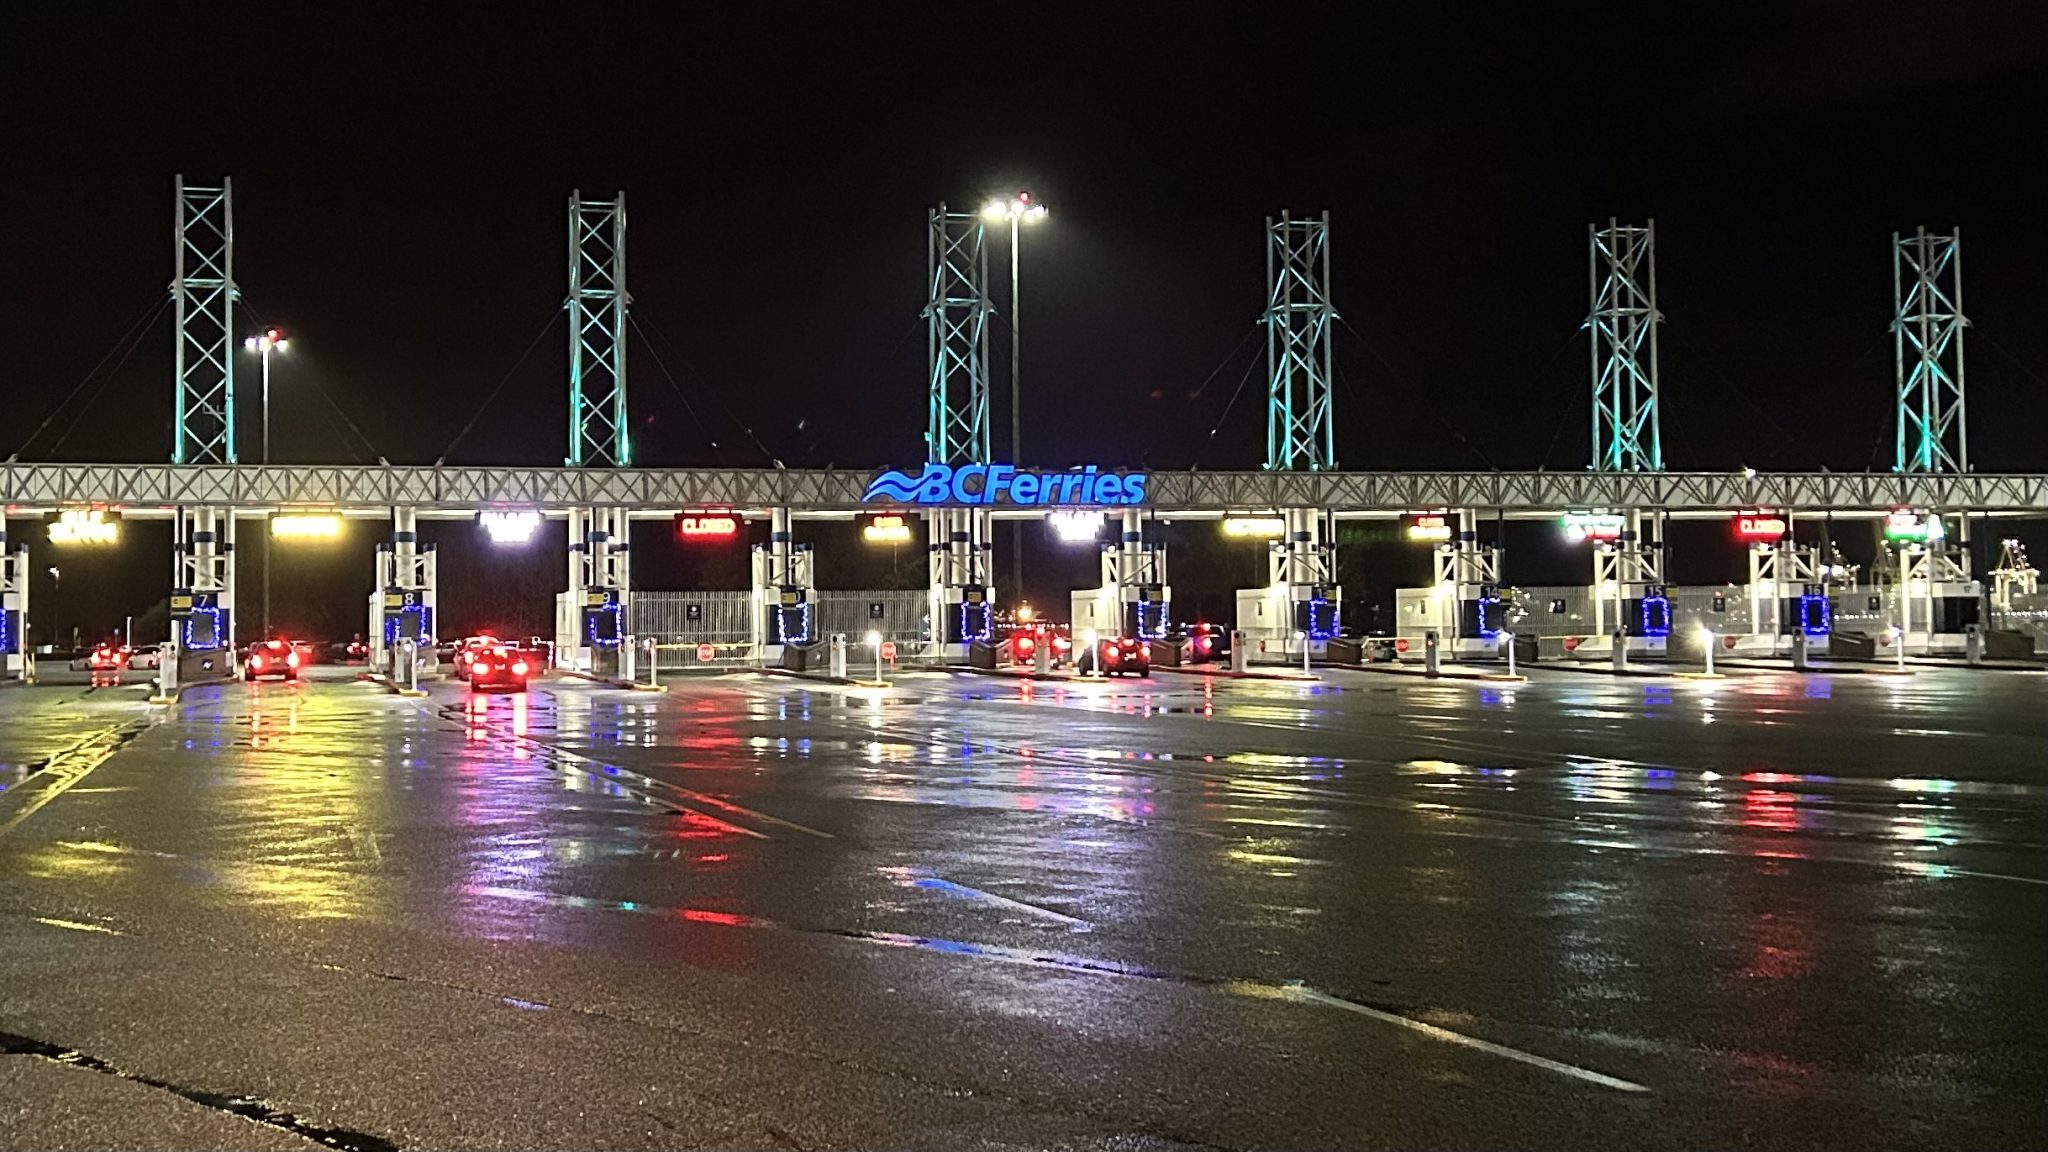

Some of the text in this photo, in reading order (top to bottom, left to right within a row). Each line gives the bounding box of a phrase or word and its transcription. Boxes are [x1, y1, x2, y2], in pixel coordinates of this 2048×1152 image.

[682, 518, 735, 534] CLOSED
[1740, 519, 1785, 534] CLOSED
[1485, 586, 1499, 598] 14
[1649, 586, 1663, 597] 15
[1808, 585, 1821, 596] 16
[198, 594, 208, 607] 7
[404, 592, 415, 605] 8
[603, 591, 611, 604] 9
